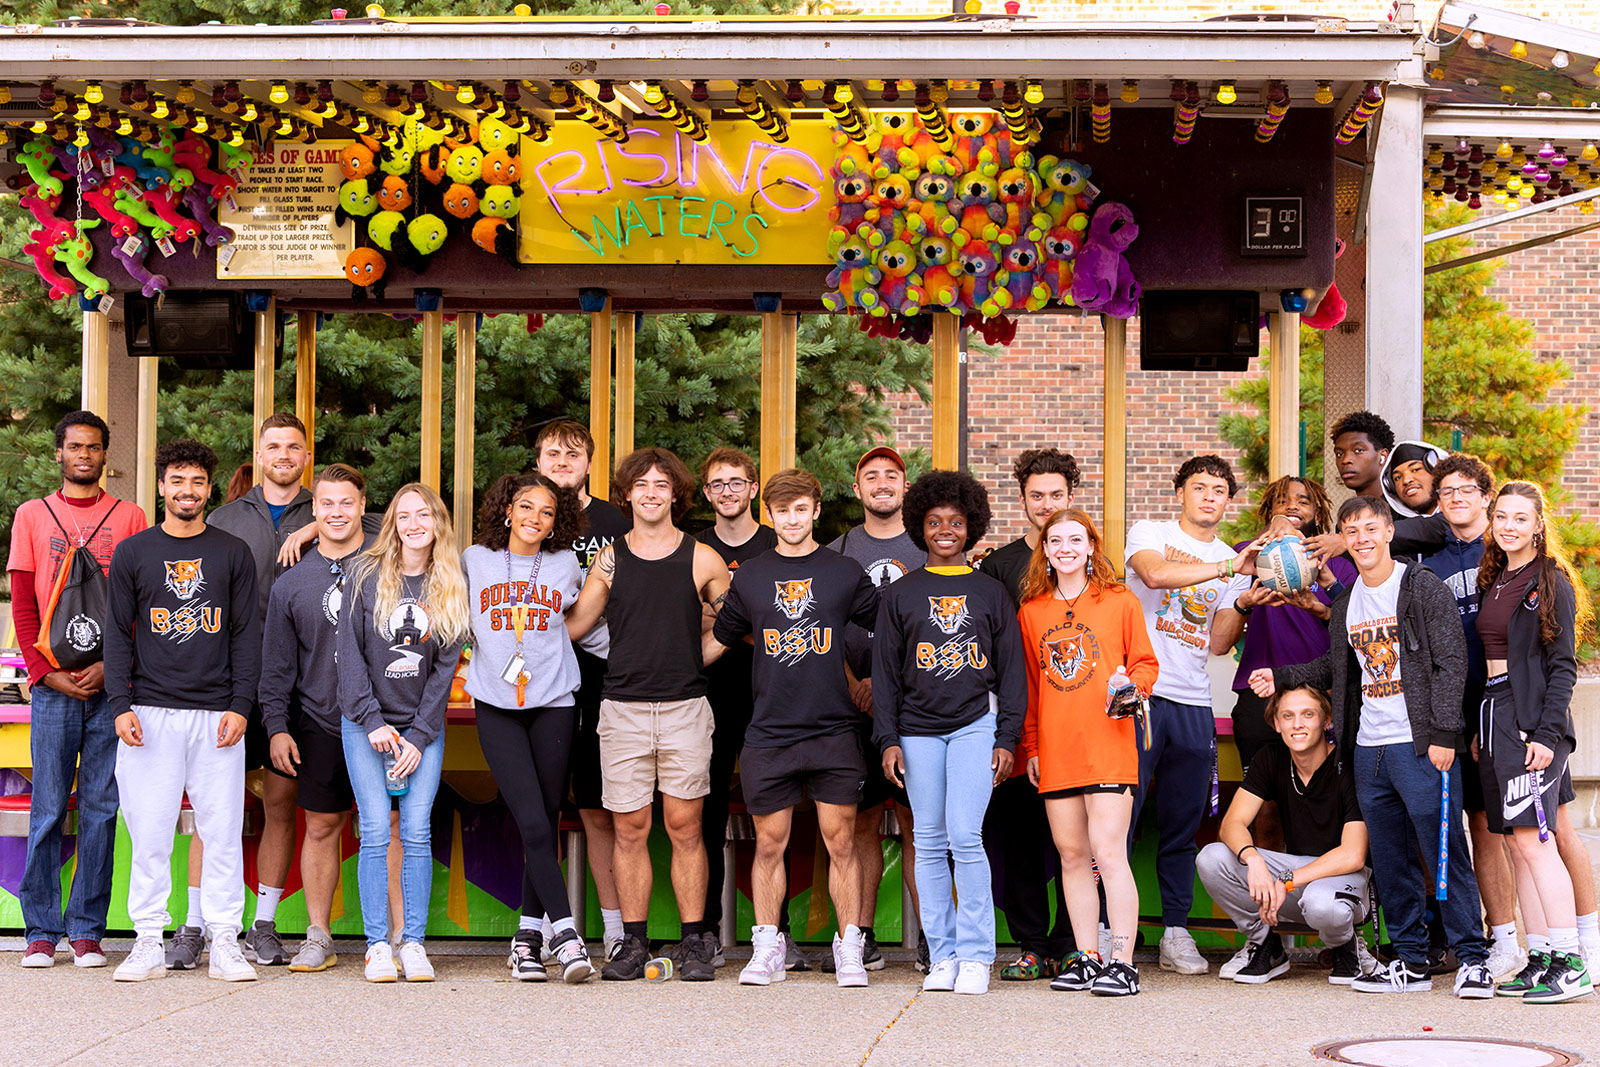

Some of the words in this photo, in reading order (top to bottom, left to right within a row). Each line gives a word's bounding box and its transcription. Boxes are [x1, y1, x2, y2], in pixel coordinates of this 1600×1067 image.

[280, 150, 300, 164] OF
[534, 127, 825, 213] RISING
[571, 195, 768, 257] WATERS
[1254, 207, 1272, 237] 3
[1279, 209, 1297, 223] 00
[571, 536, 615, 551] GAN
[1272, 553, 1288, 588] molten
[480, 581, 563, 614] BUFFALO
[150, 607, 222, 634] BSU
[1376, 616, 1397, 626] STATE
[762, 627, 833, 655] BSU
[1039, 621, 1073, 670] BUFFALO
[1075, 622, 1100, 660] STATE
[1349, 624, 1400, 650] ROAR
[384, 670, 401, 679] LEAD
[401, 670, 419, 679] HOME
[1367, 678, 1405, 698] SUCCES
